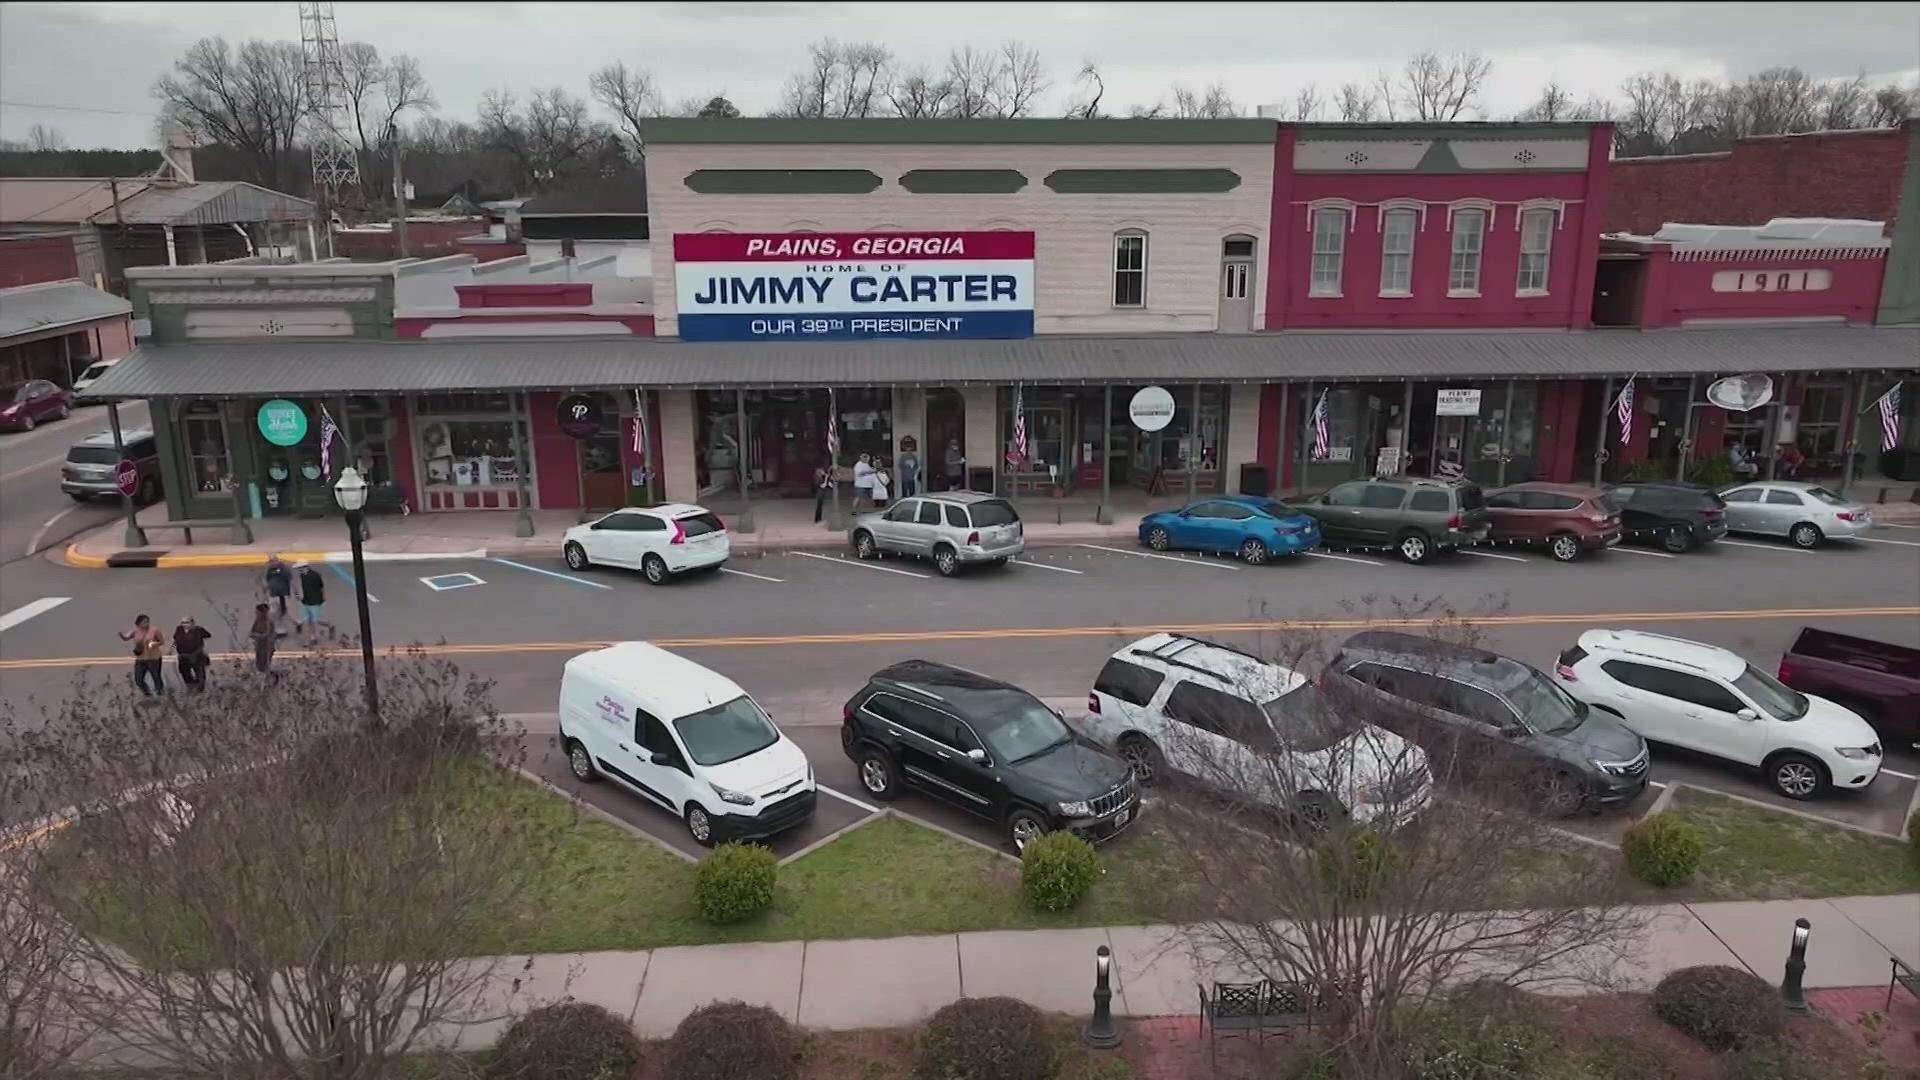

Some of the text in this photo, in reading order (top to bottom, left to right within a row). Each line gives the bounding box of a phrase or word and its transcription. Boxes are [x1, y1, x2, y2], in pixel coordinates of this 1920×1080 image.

[746, 237, 965, 257] PLAINS, GEORGIA
[806, 264, 907, 273] HOME OF
[695, 275, 1017, 304] JIMMY CARTER
[1738, 272, 1808, 290] 1901
[751, 317, 963, 334] OUR 39TH PRESIDENT
[119, 469, 136, 487] STOP
